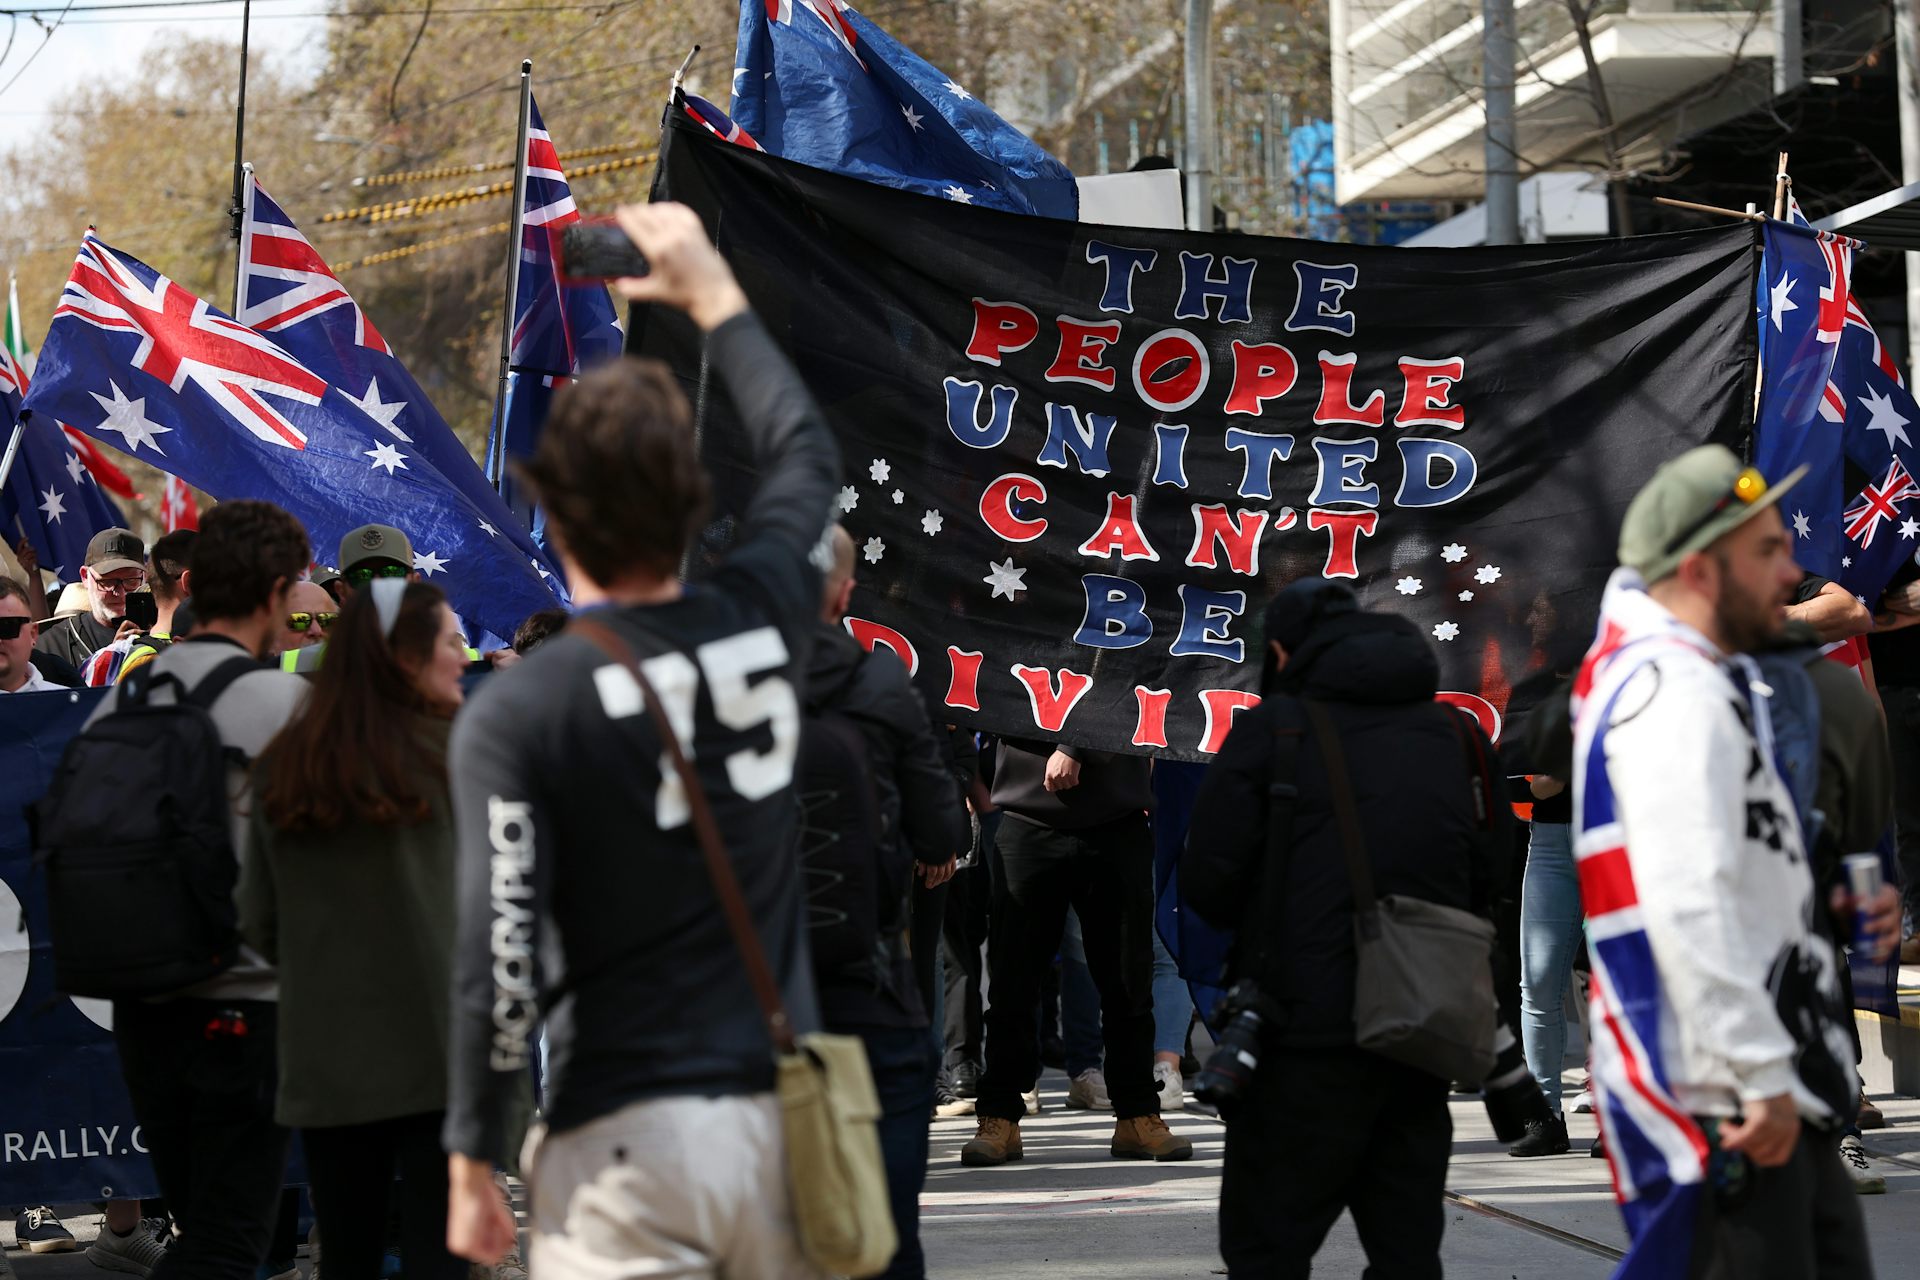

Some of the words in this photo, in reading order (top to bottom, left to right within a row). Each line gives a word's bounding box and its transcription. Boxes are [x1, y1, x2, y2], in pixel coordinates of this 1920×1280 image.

[1087, 240, 1358, 336] THE
[965, 297, 1465, 430] PEOPLE
[943, 376, 1478, 508] UNITED
[979, 472, 1379, 579] CAN'T
[1073, 573, 1246, 663] BE
[593, 626, 799, 831] 75
[842, 616, 1501, 754] DIVI
